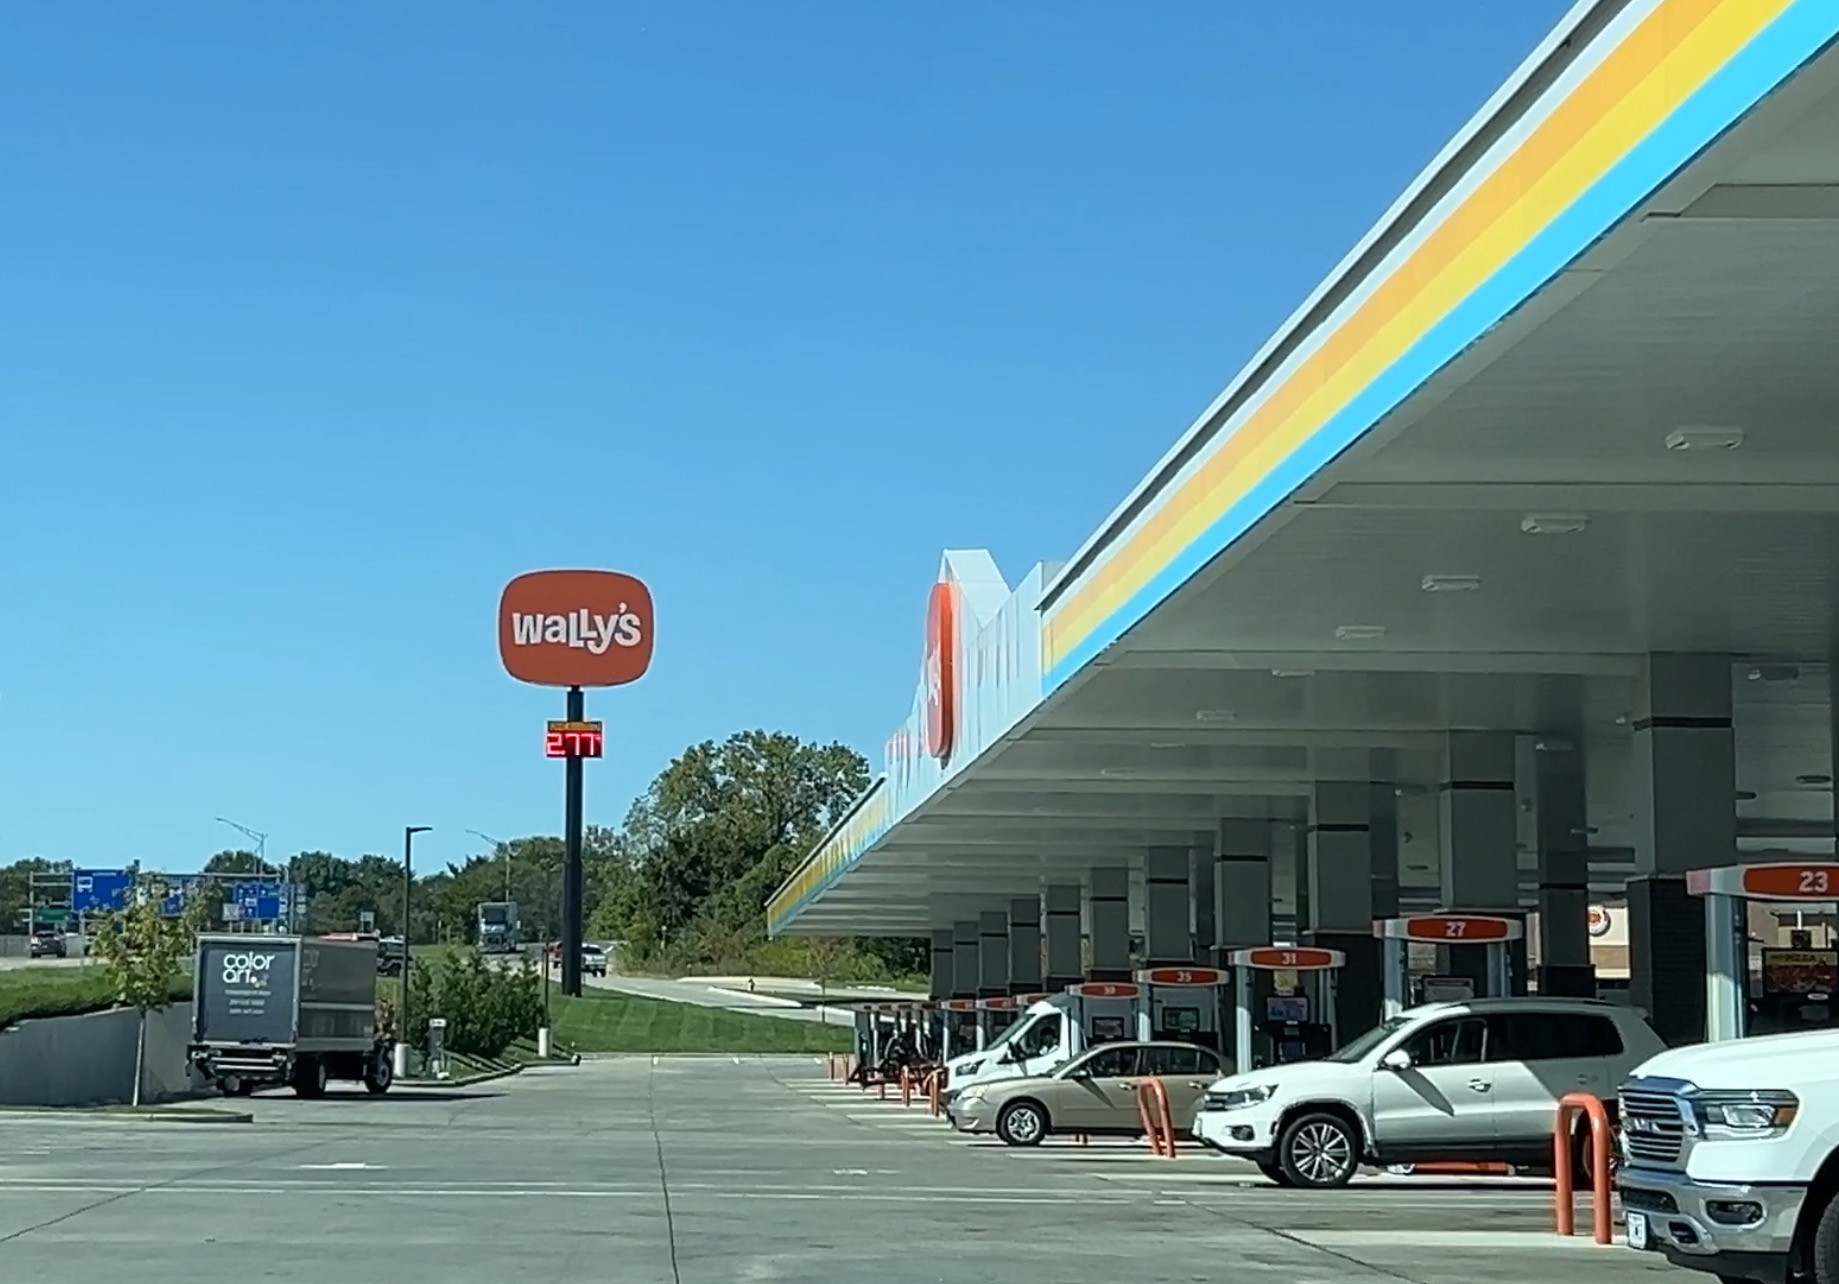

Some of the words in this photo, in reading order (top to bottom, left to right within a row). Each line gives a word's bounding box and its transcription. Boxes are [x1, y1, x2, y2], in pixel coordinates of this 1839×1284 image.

[1798, 870, 1829, 893] 23
[1444, 921, 1467, 937] 27
[223, 950, 276, 970] color
[1281, 952, 1297, 965] 31
[1176, 971, 1192, 983] 35
